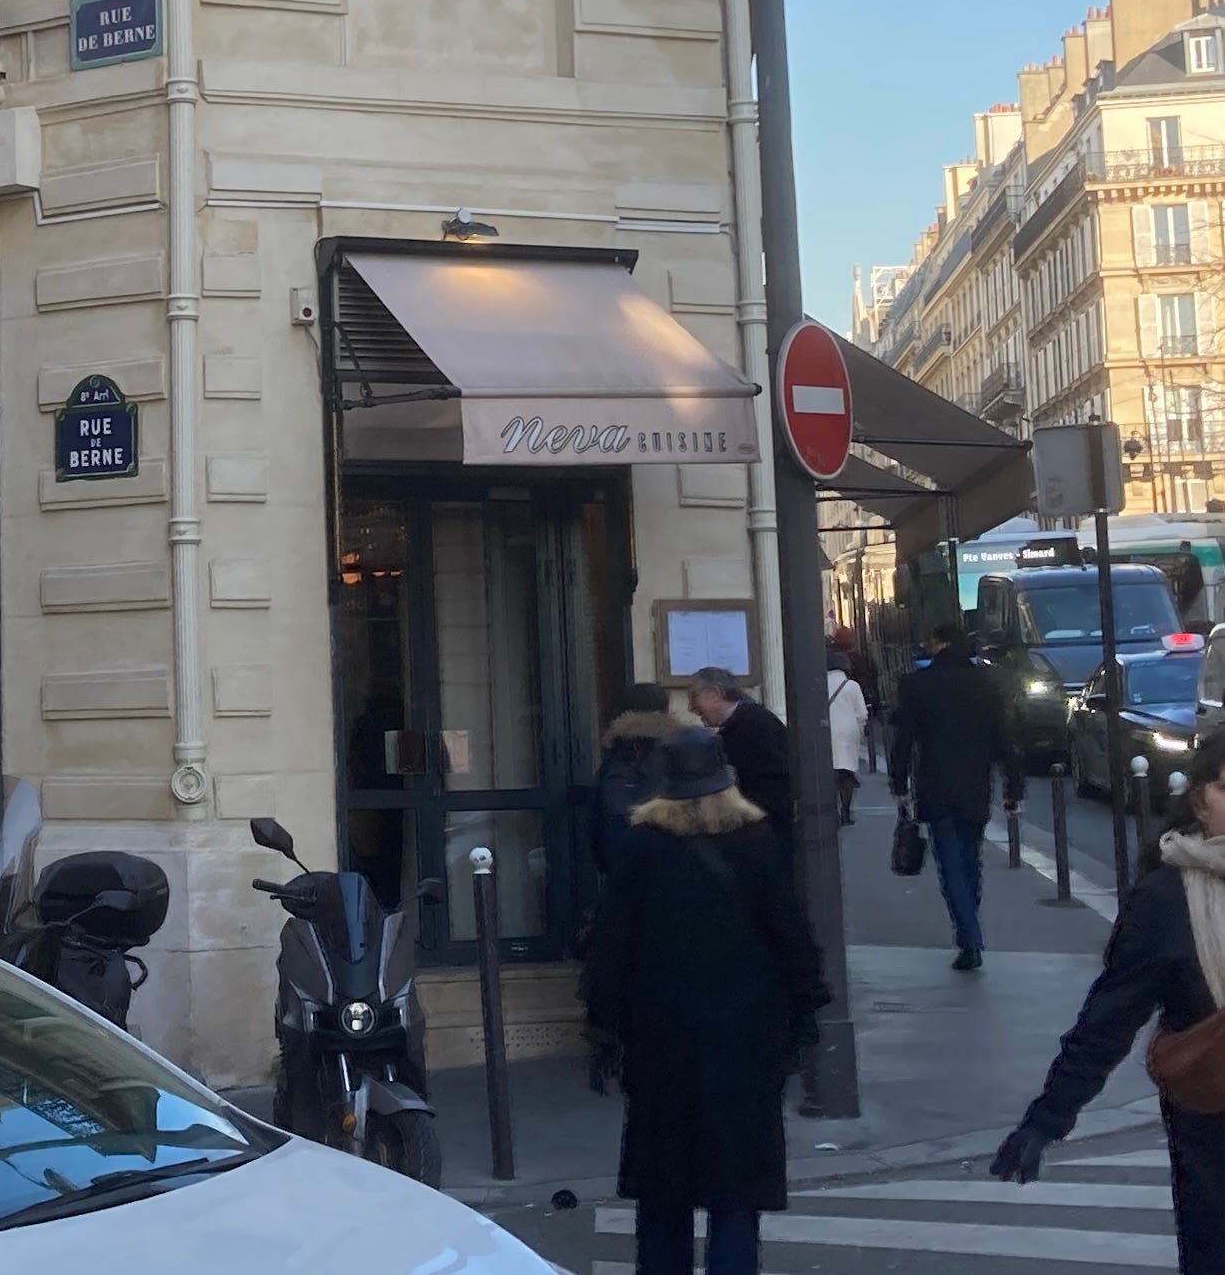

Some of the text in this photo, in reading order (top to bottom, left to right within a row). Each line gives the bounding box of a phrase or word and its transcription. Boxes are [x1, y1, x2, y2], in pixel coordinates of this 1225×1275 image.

[99, 6, 132, 26] RUE
[78, 24, 156, 52] DE BERNE
[79, 417, 112, 437] RUE
[500, 416, 727, 454] Neva CUISINE
[90, 438, 102, 448] DE
[70, 447, 124, 468] BERNE
